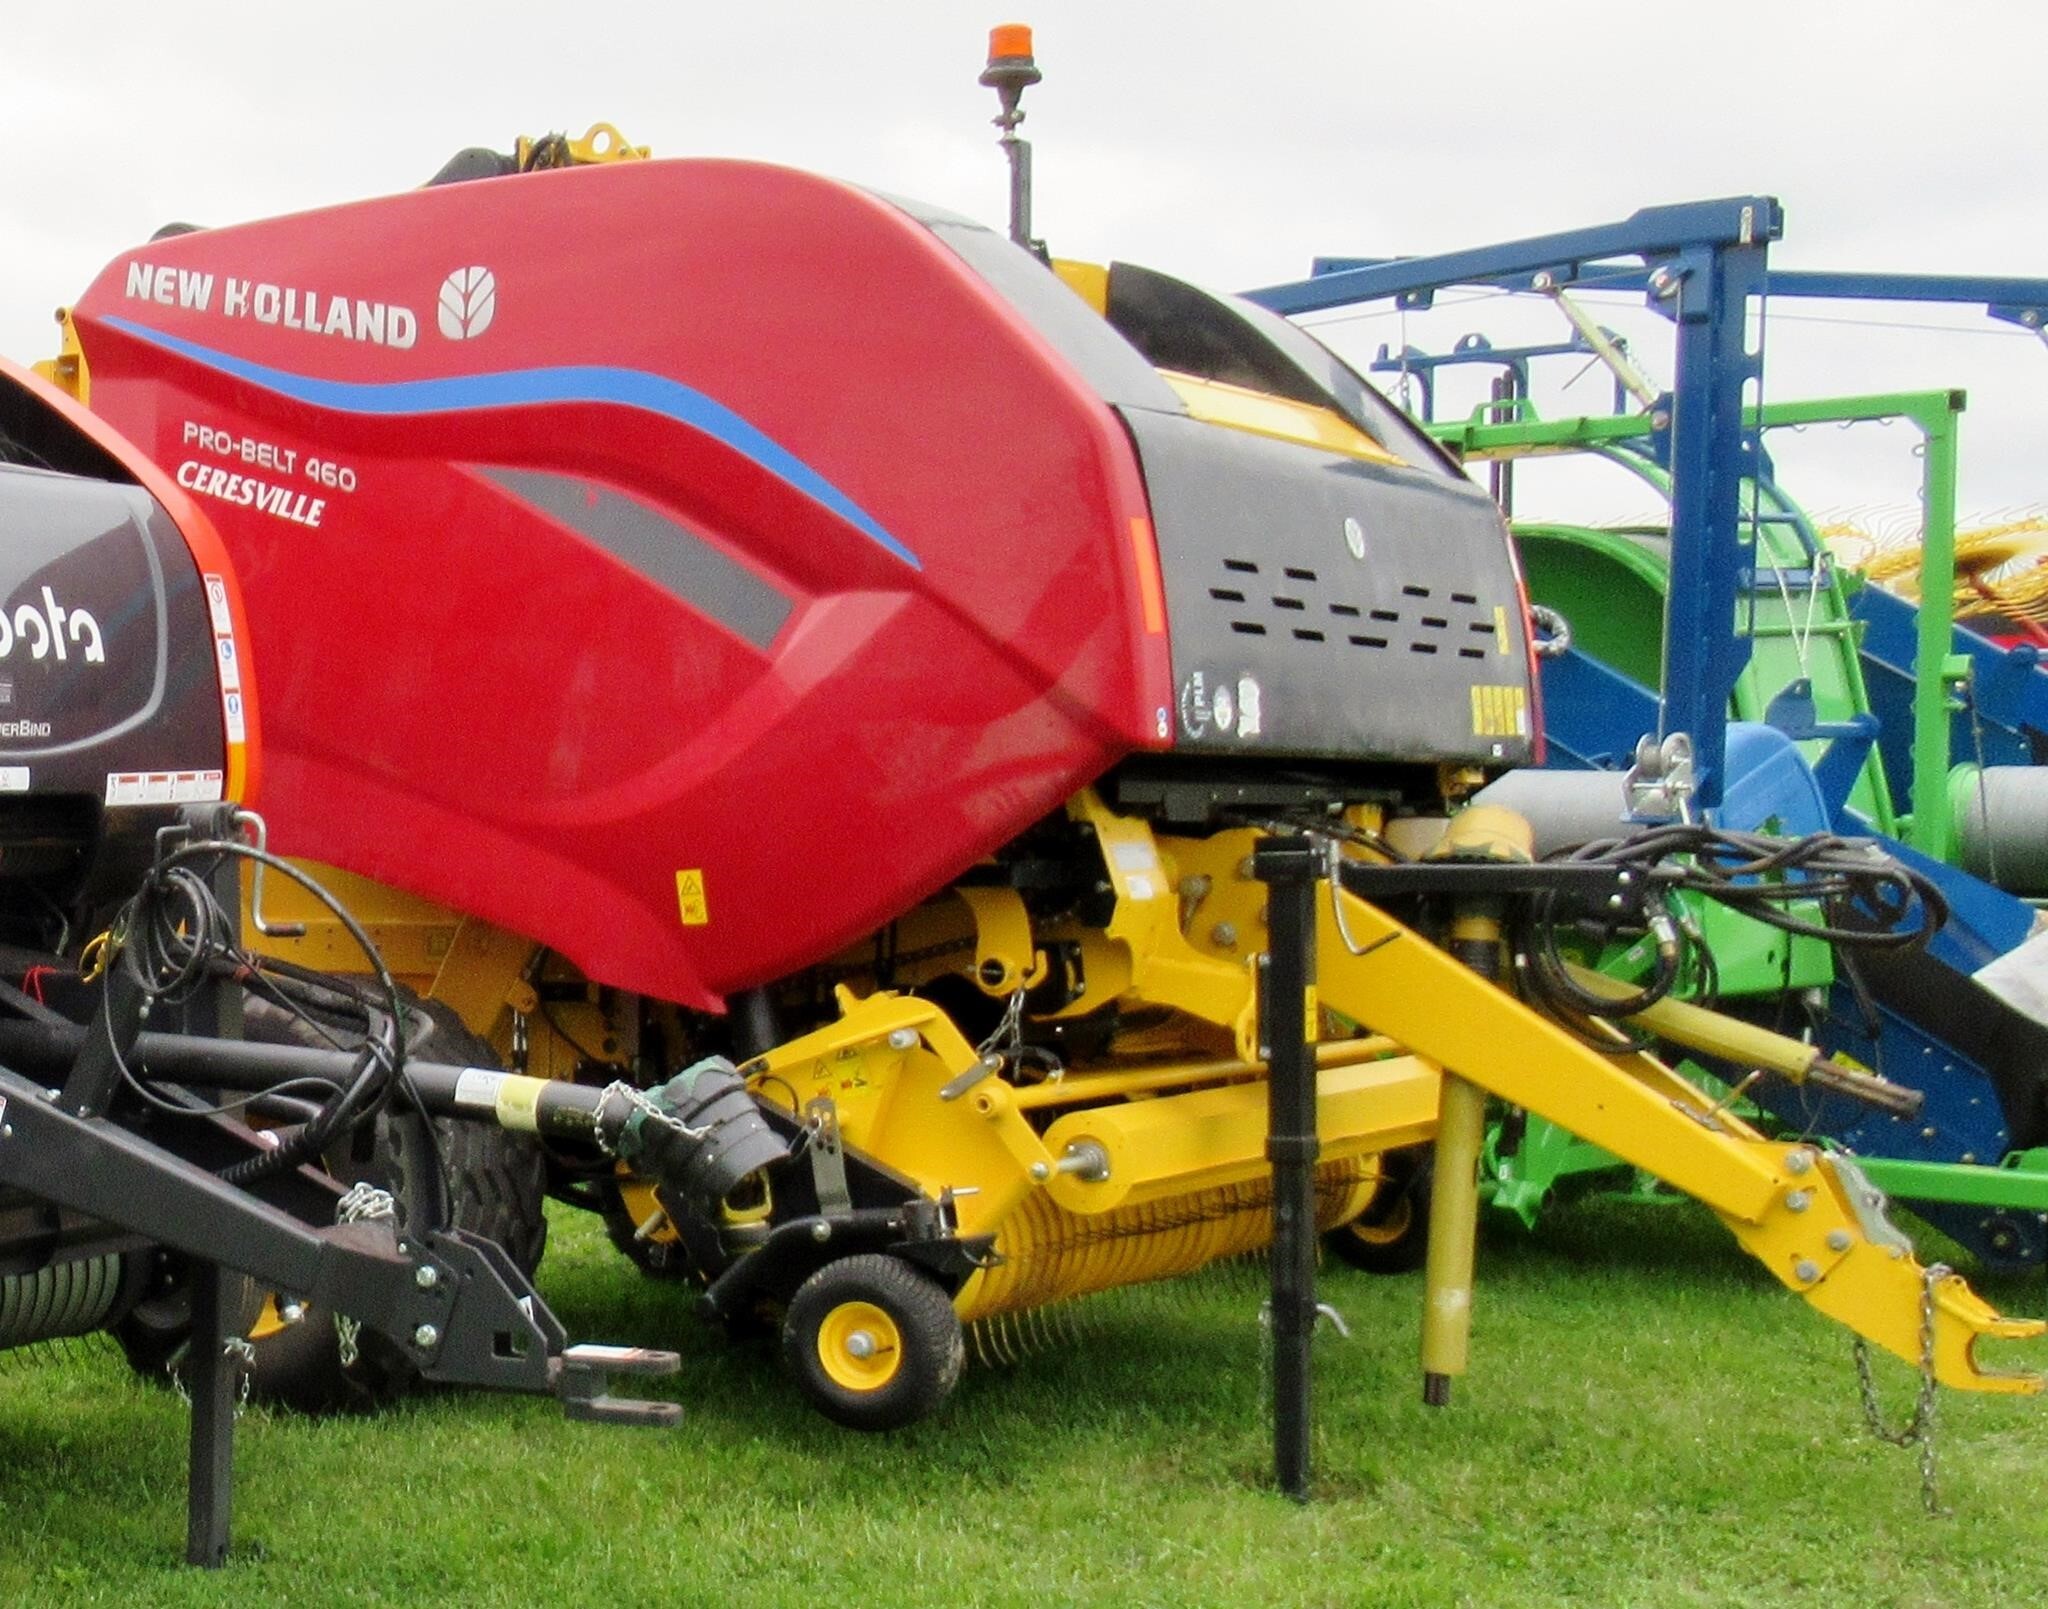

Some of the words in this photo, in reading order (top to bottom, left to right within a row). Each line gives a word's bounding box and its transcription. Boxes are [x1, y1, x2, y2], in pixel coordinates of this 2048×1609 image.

[125, 261, 214, 312] NEW
[224, 277, 419, 349] HOLLAND
[183, 421, 298, 474] PRO-BELT
[304, 460, 358, 493] 460
[176, 461, 326, 527] CERESVILLE
